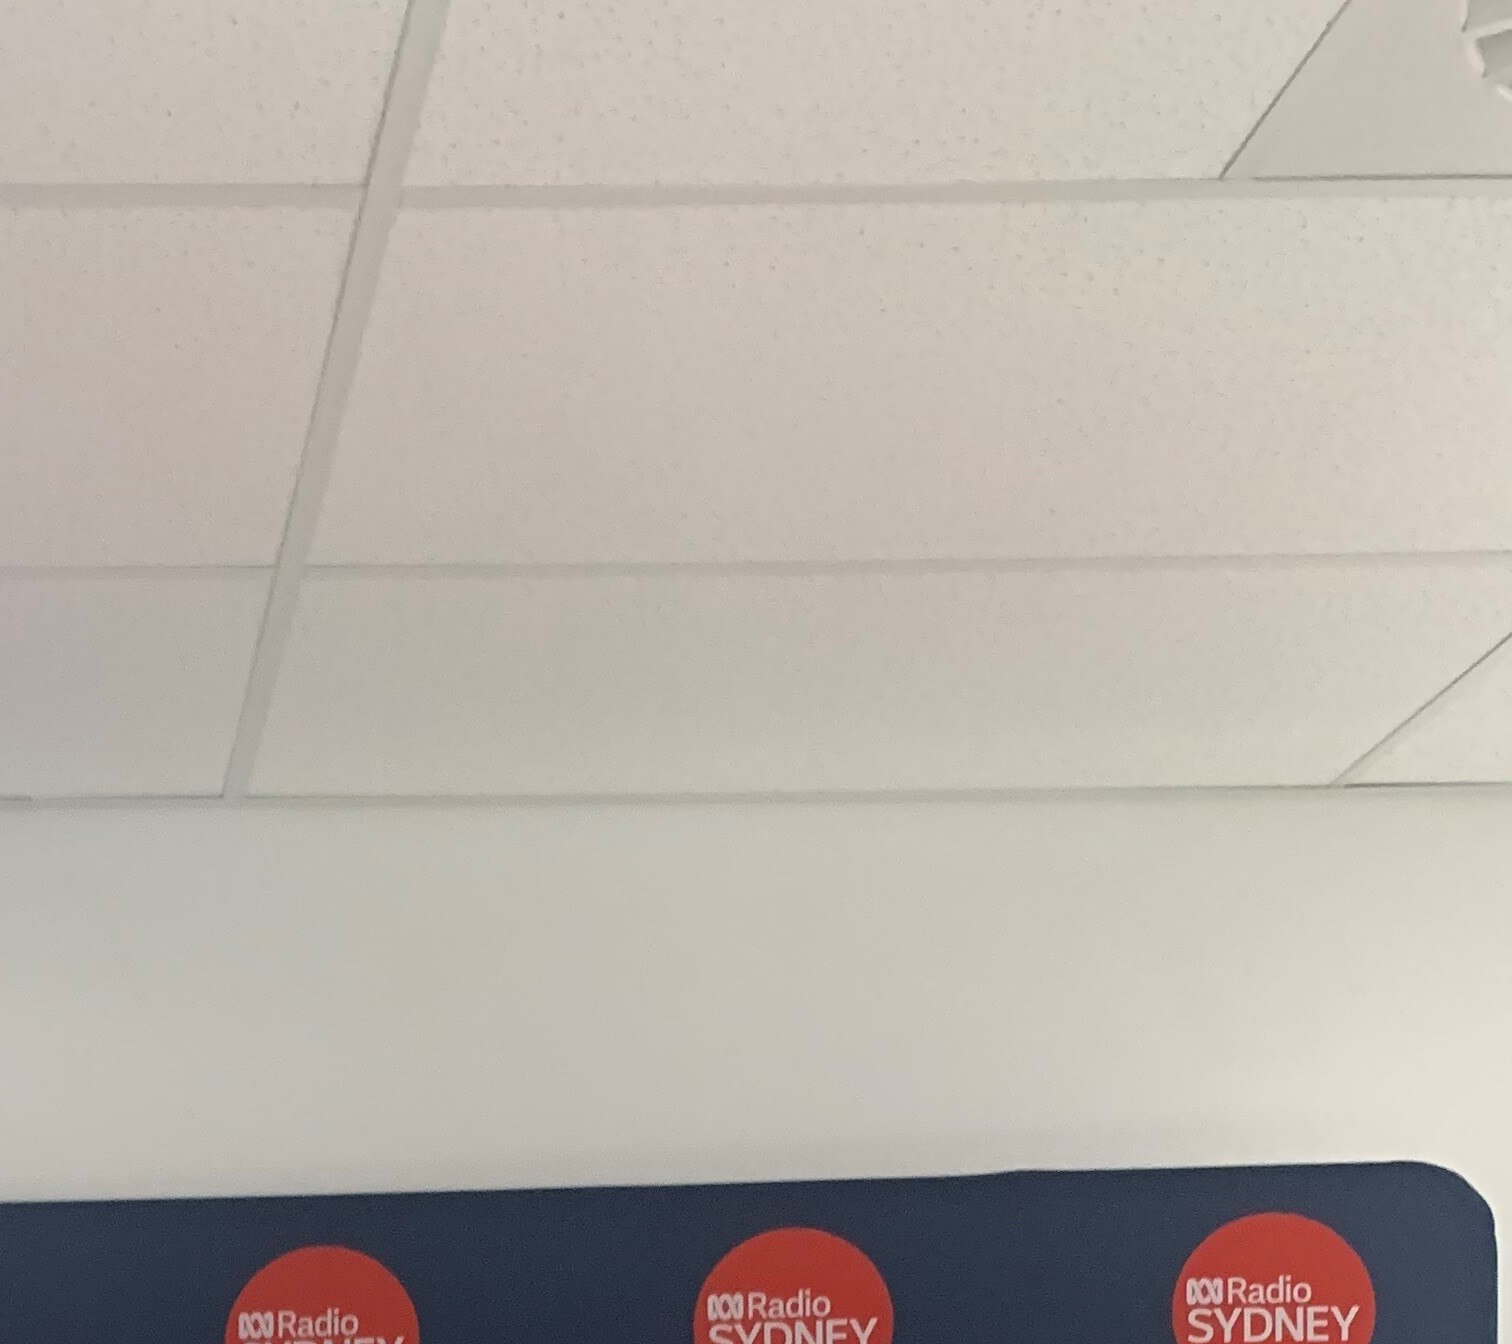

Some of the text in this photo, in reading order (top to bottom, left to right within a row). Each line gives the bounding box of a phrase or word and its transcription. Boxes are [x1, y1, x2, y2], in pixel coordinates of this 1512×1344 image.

[747, 1290, 832, 1318] Radio
[1226, 1276, 1312, 1304] Radio
[277, 1309, 359, 1339] Radio
[1187, 1305, 1360, 1344] SYDNEY
